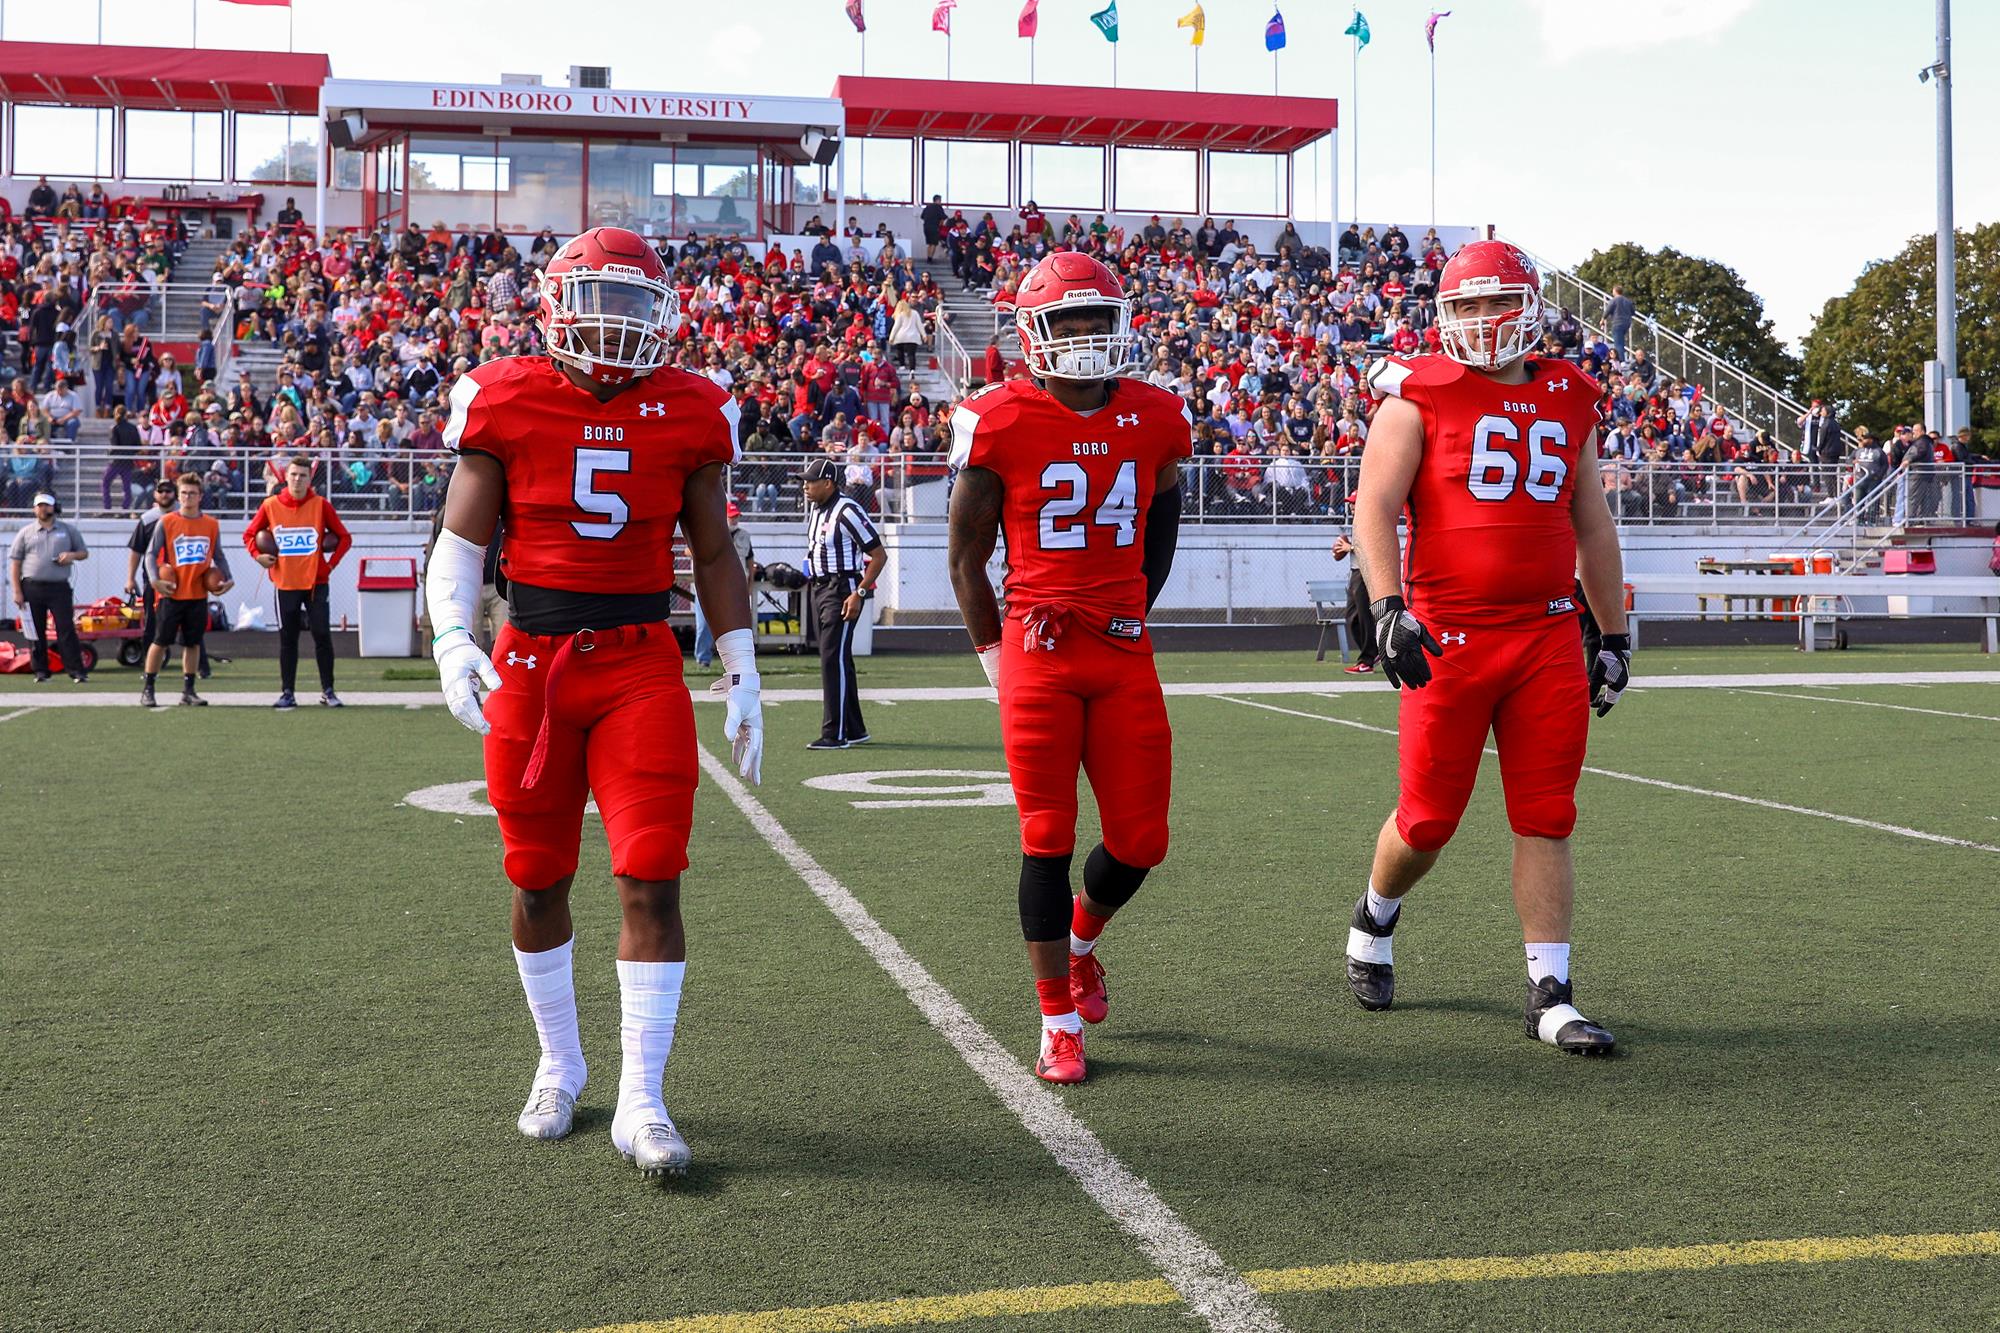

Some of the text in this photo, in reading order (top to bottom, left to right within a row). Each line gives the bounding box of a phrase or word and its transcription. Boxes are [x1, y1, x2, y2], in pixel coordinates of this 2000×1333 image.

[432, 89, 754, 118] EDINBORO UNIVERSITY
[607, 265, 642, 276] Riddell
[1067, 291, 1098, 299] Riddell
[1503, 400, 1537, 414] BORO
[584, 425, 625, 442] BORO
[1072, 442, 1109, 456] BORO
[1467, 413, 1569, 502] 66
[569, 447, 632, 541] 5
[1038, 459, 1139, 550] 24
